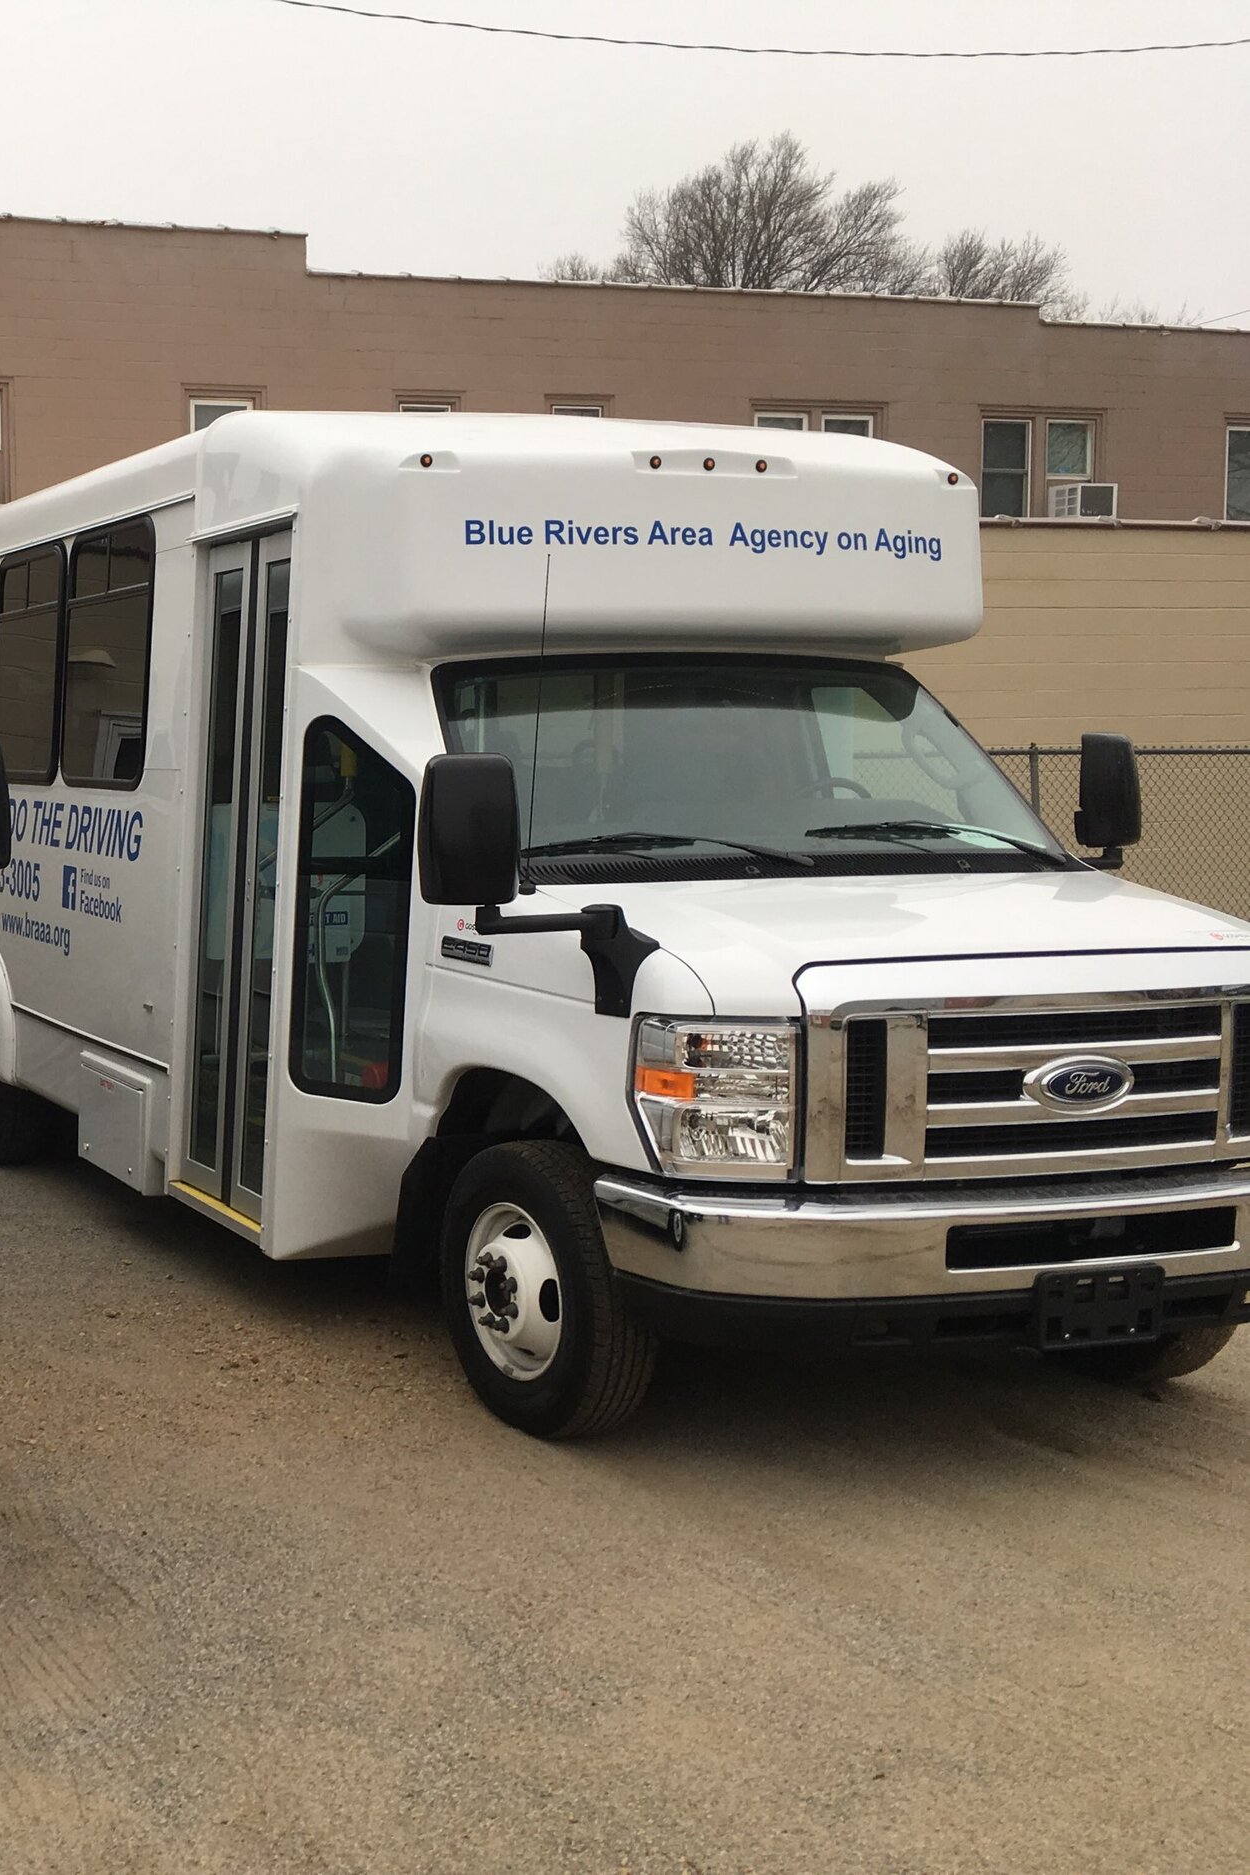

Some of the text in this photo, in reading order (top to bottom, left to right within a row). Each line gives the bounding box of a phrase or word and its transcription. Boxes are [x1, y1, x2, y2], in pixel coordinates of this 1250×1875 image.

[463, 518, 942, 562] Blue Rivers Area Agency on Aging
[31, 801, 64, 848] THE
[65, 804, 143, 862] DRIVING
[80, 868, 110, 889] Find us on
[80, 889, 122, 923] Facebook
[2, 912, 70, 956] www.braaa.org
[1064, 1071, 1112, 1095] Ford
